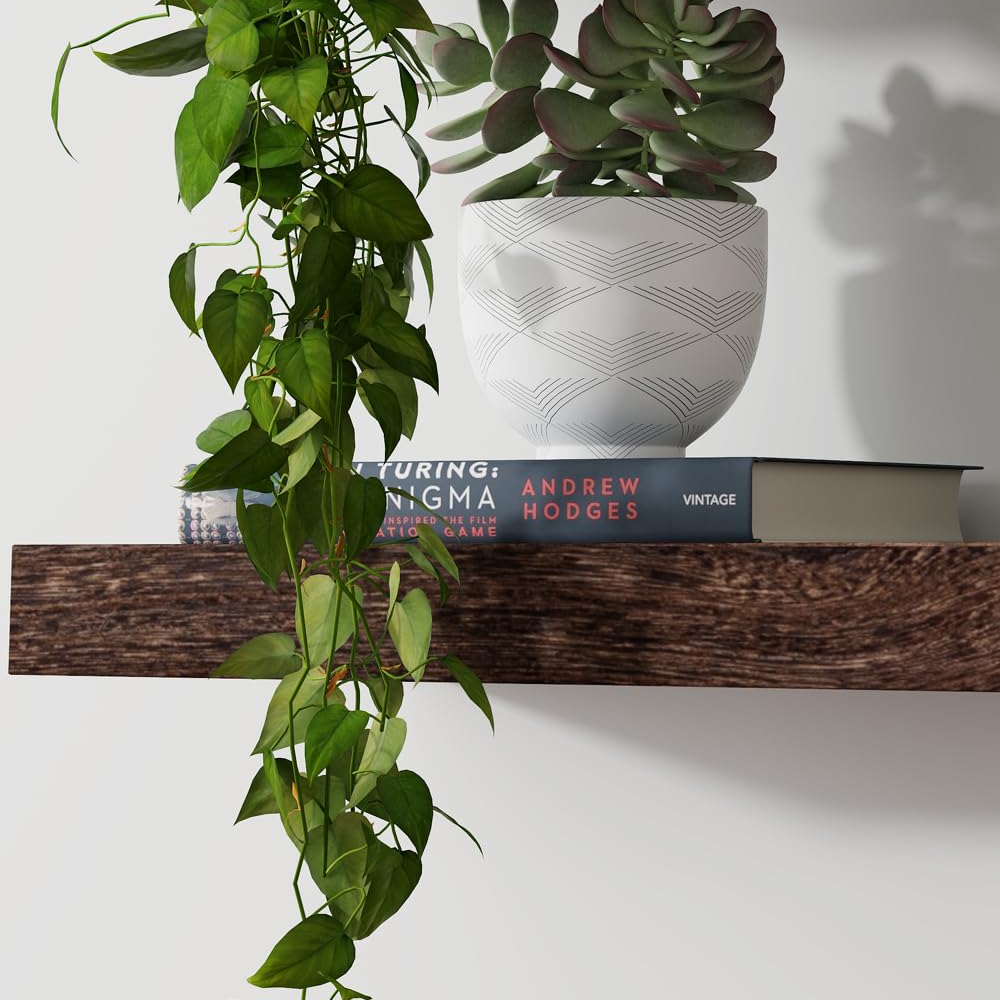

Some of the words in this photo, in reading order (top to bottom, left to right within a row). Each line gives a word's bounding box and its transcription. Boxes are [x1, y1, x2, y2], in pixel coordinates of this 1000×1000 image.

[377, 461, 499, 480] TURING:
[522, 477, 640, 496] ANDREW
[385, 485, 496, 511] NIGMA
[683, 494, 737, 506] VINTAGE
[470, 516, 497, 525] FILM
[523, 502, 639, 521] HODGES
[444, 526, 497, 537] GAME
